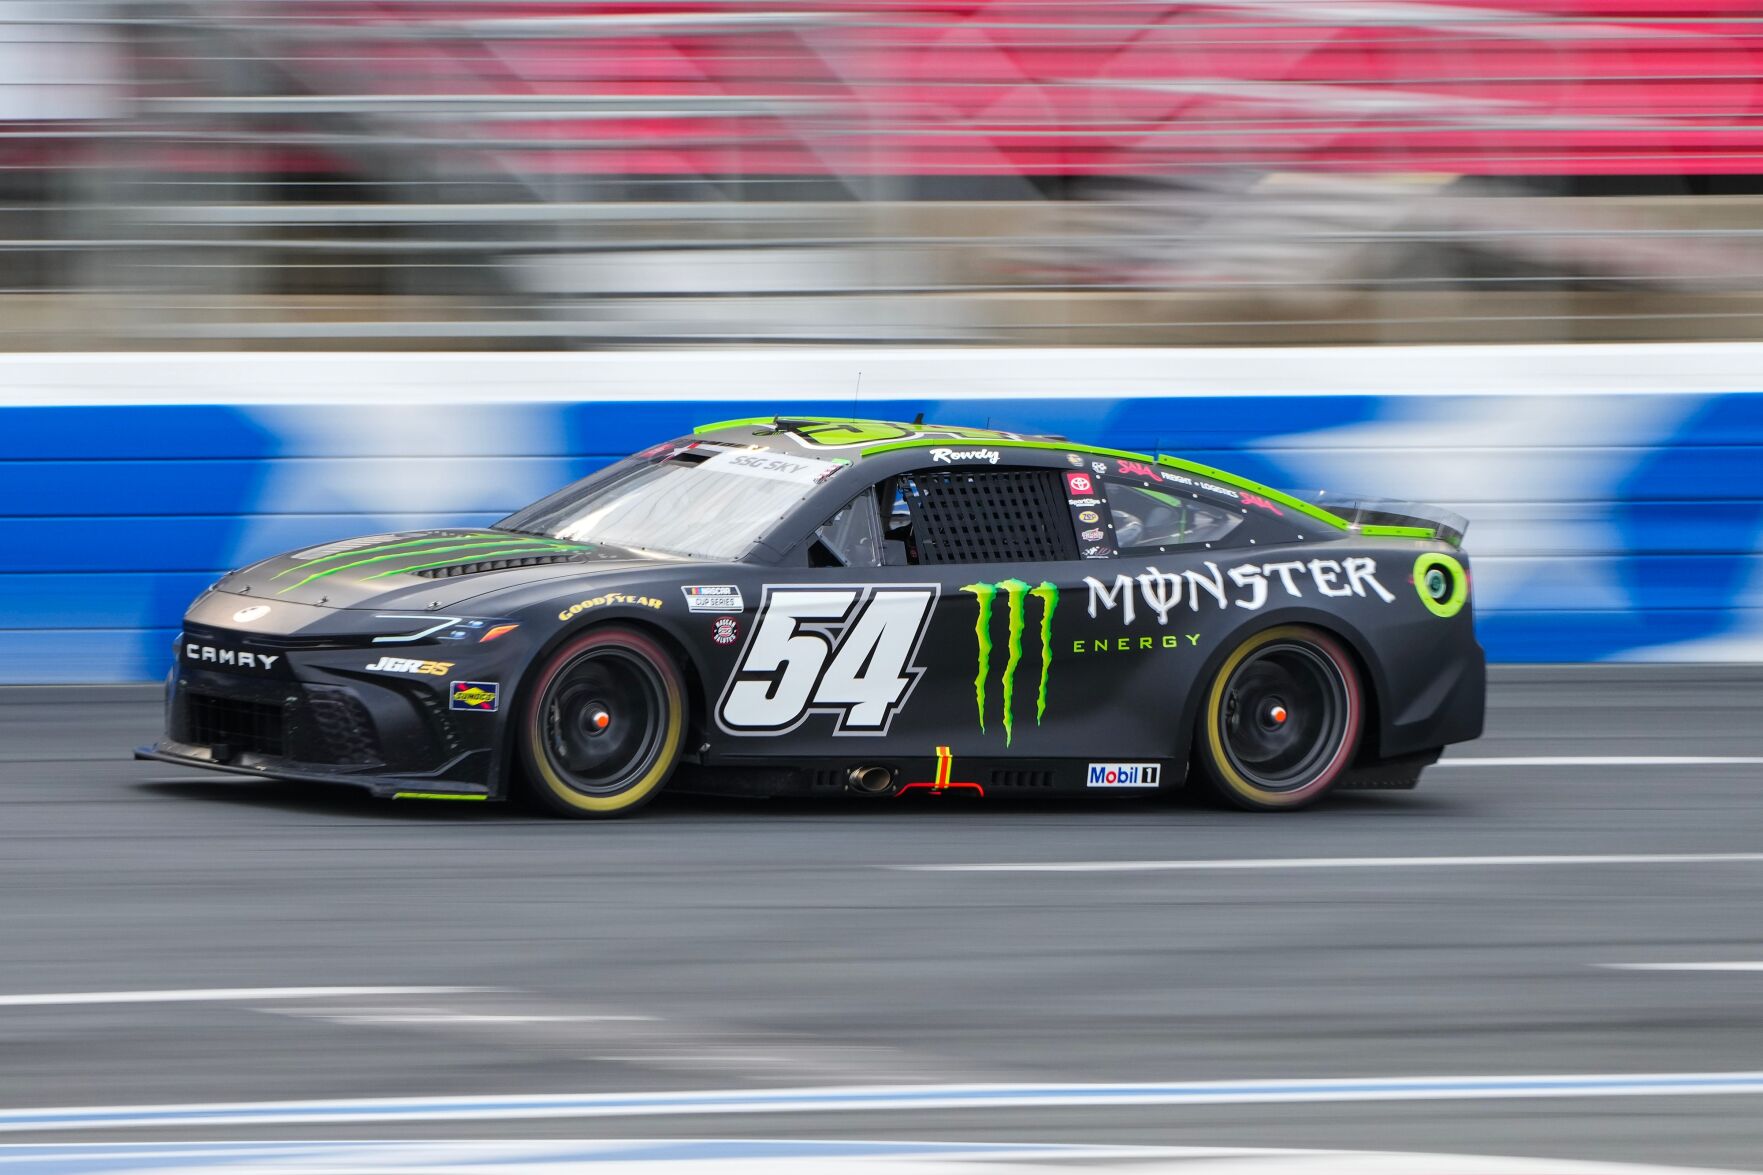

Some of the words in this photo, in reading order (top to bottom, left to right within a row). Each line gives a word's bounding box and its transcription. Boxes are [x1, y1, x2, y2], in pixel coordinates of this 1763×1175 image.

[729, 455, 764, 470] SSG
[765, 461, 809, 474] SKY
[929, 448, 1000, 464] Rowdy
[1161, 471, 1193, 485] FREIGHT
[1200, 482, 1239, 498] LOGISTICS
[702, 587, 732, 595] NASCAR
[1082, 557, 1396, 625] MONSTER
[558, 592, 663, 622] GOODYEAR
[696, 598, 709, 606] CUP
[711, 598, 735, 606] SERIES
[1073, 633, 1201, 653] ENERGY
[186, 643, 279, 670] CAMRY
[365, 656, 456, 676] JGR35
[718, 586, 937, 732] 54
[455, 692, 495, 702] SUNOCO
[1089, 766, 1138, 784] Mobil
